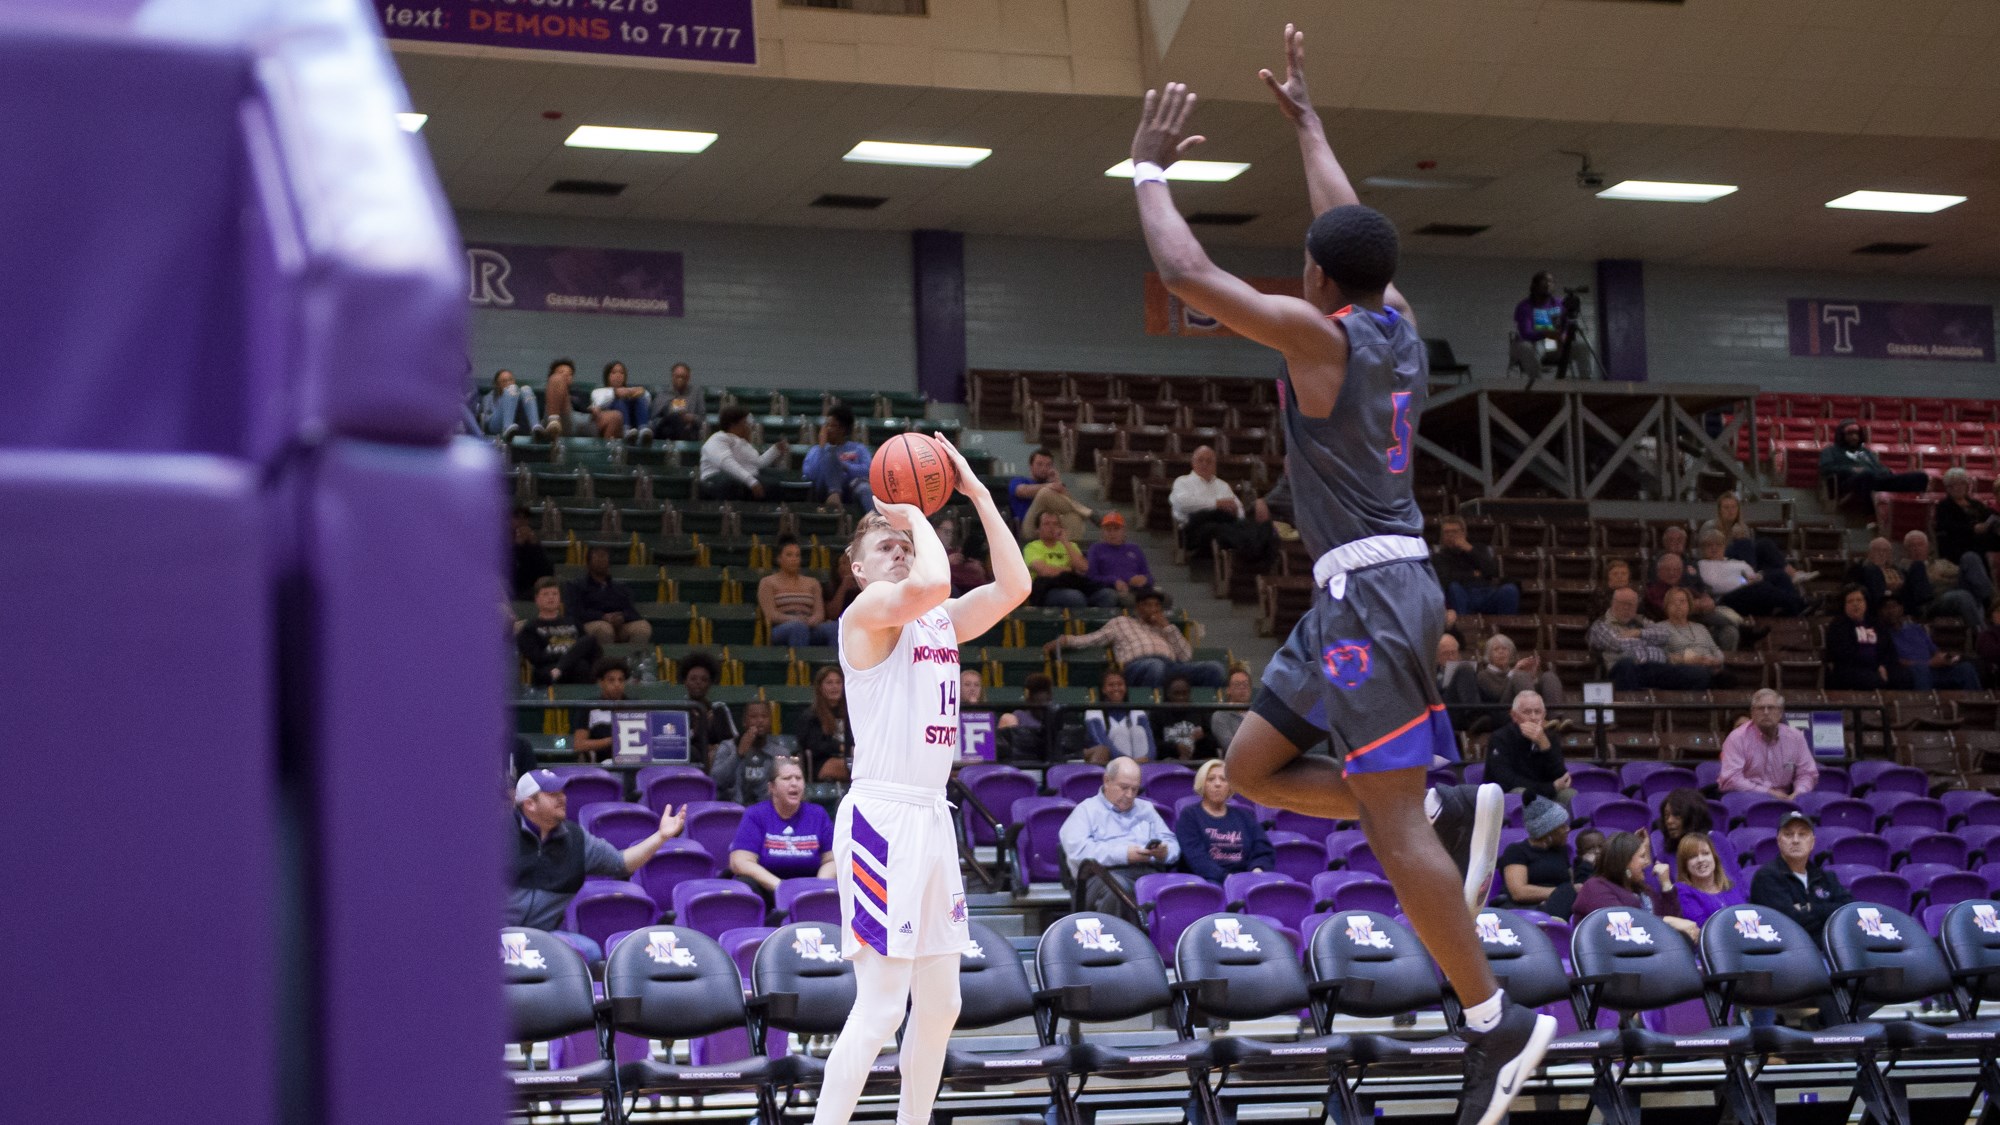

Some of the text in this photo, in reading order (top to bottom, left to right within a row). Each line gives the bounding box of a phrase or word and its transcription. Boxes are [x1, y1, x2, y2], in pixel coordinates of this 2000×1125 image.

[469, 9, 611, 40] DEMONS
[620, 21, 649, 43] to
[658, 23, 742, 48] 71777
[467, 248, 515, 306] R
[1823, 304, 1860, 353] T
[1386, 391, 1413, 474] 5
[887, 470, 898, 495] ROCK
[939, 680, 957, 716] 14
[618, 720, 648, 756] E
[963, 721, 992, 754] F
[1744, 920, 1759, 934] N
[1866, 918, 1881, 932] N
[1983, 914, 1997, 928] N
[1084, 929, 1101, 944] N
[1223, 929, 1239, 943] N
[1356, 926, 1371, 940] N
[1484, 924, 1499, 938] N
[1616, 922, 1631, 936] N
[508, 944, 522, 960] N
[657, 943, 673, 958] N
[804, 939, 819, 954] N
